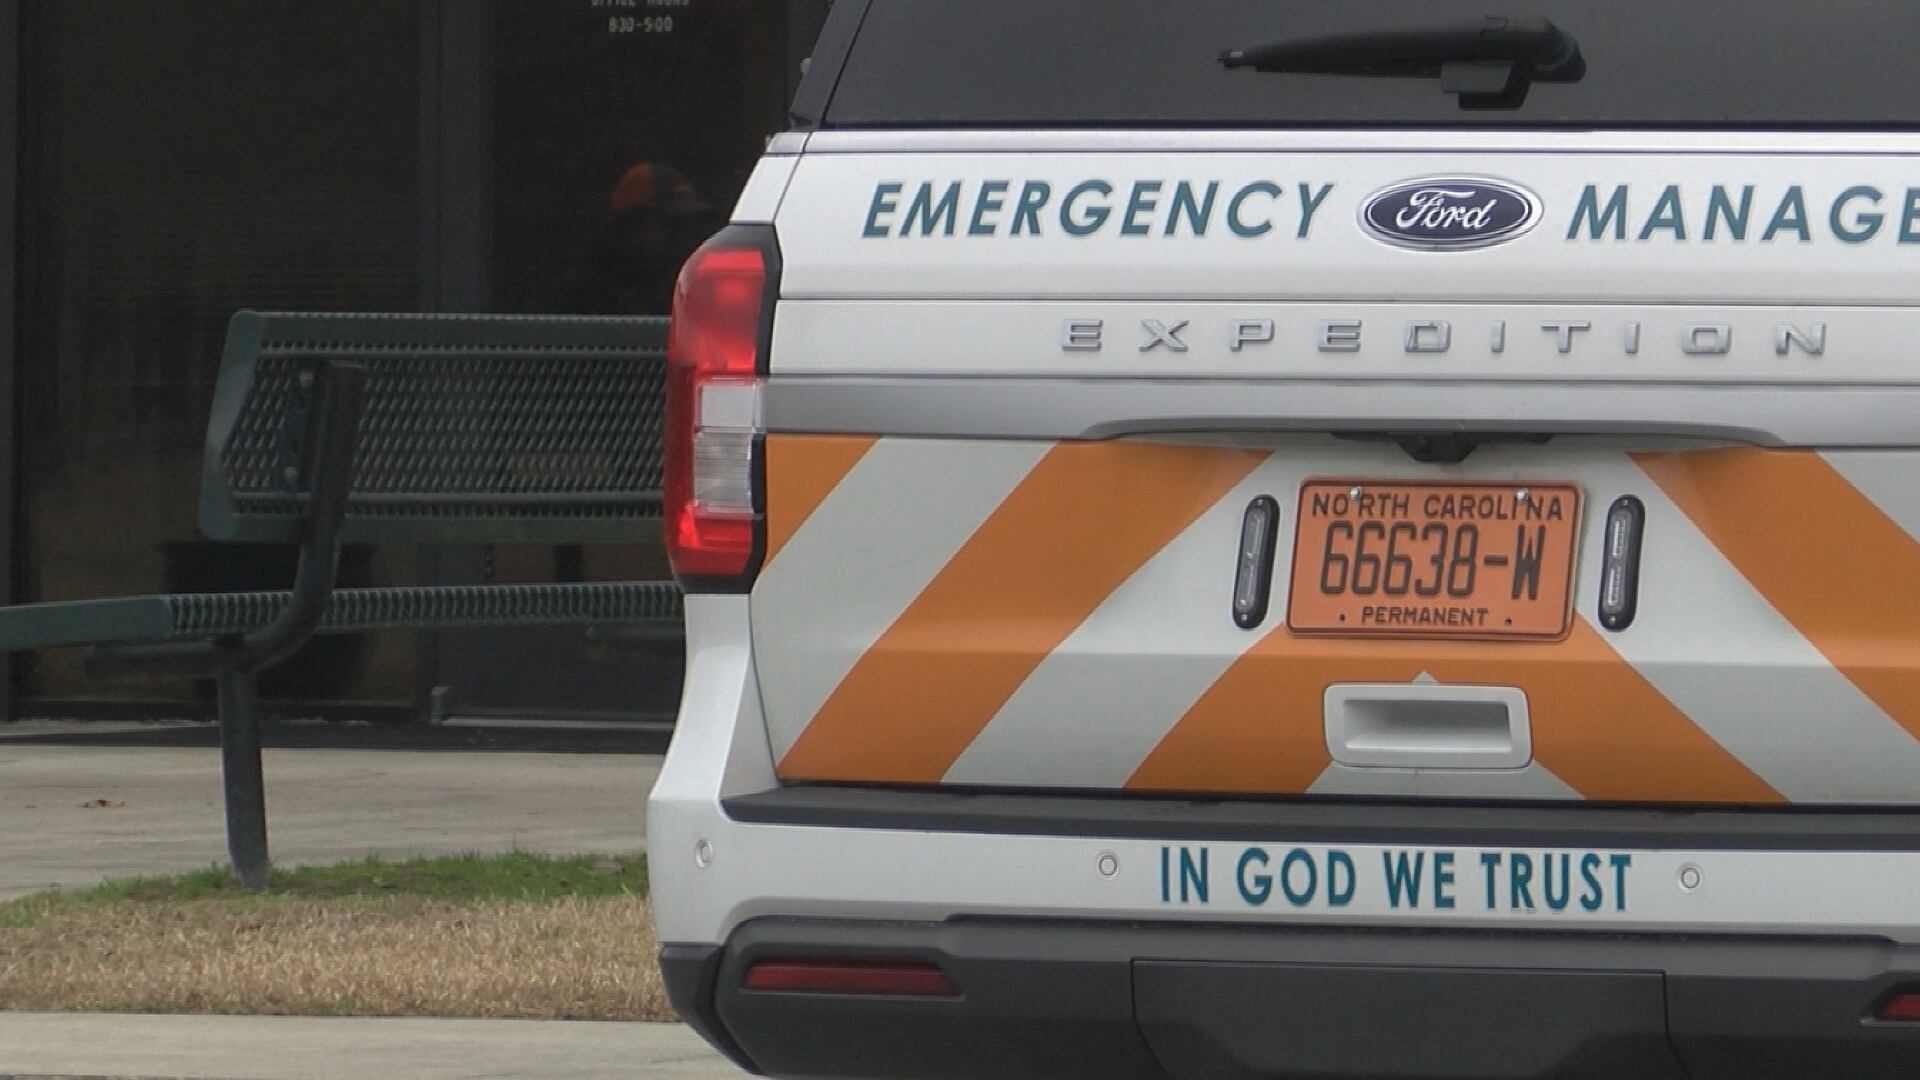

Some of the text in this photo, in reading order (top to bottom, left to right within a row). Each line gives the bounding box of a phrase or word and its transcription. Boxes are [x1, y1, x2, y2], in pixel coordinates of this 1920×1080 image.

[862, 179, 1920, 245] EMERGENCY MANAGE
[1396, 190, 1498, 229] Ford
[1061, 319, 1826, 355] EXPEDITION
[1312, 493, 1564, 521] NORTH CAROLINA
[1320, 521, 1546, 600] 66638-W
[1361, 606, 1489, 626] PERMANENT
[1160, 846, 1632, 913] IN GOD WE TRUST
